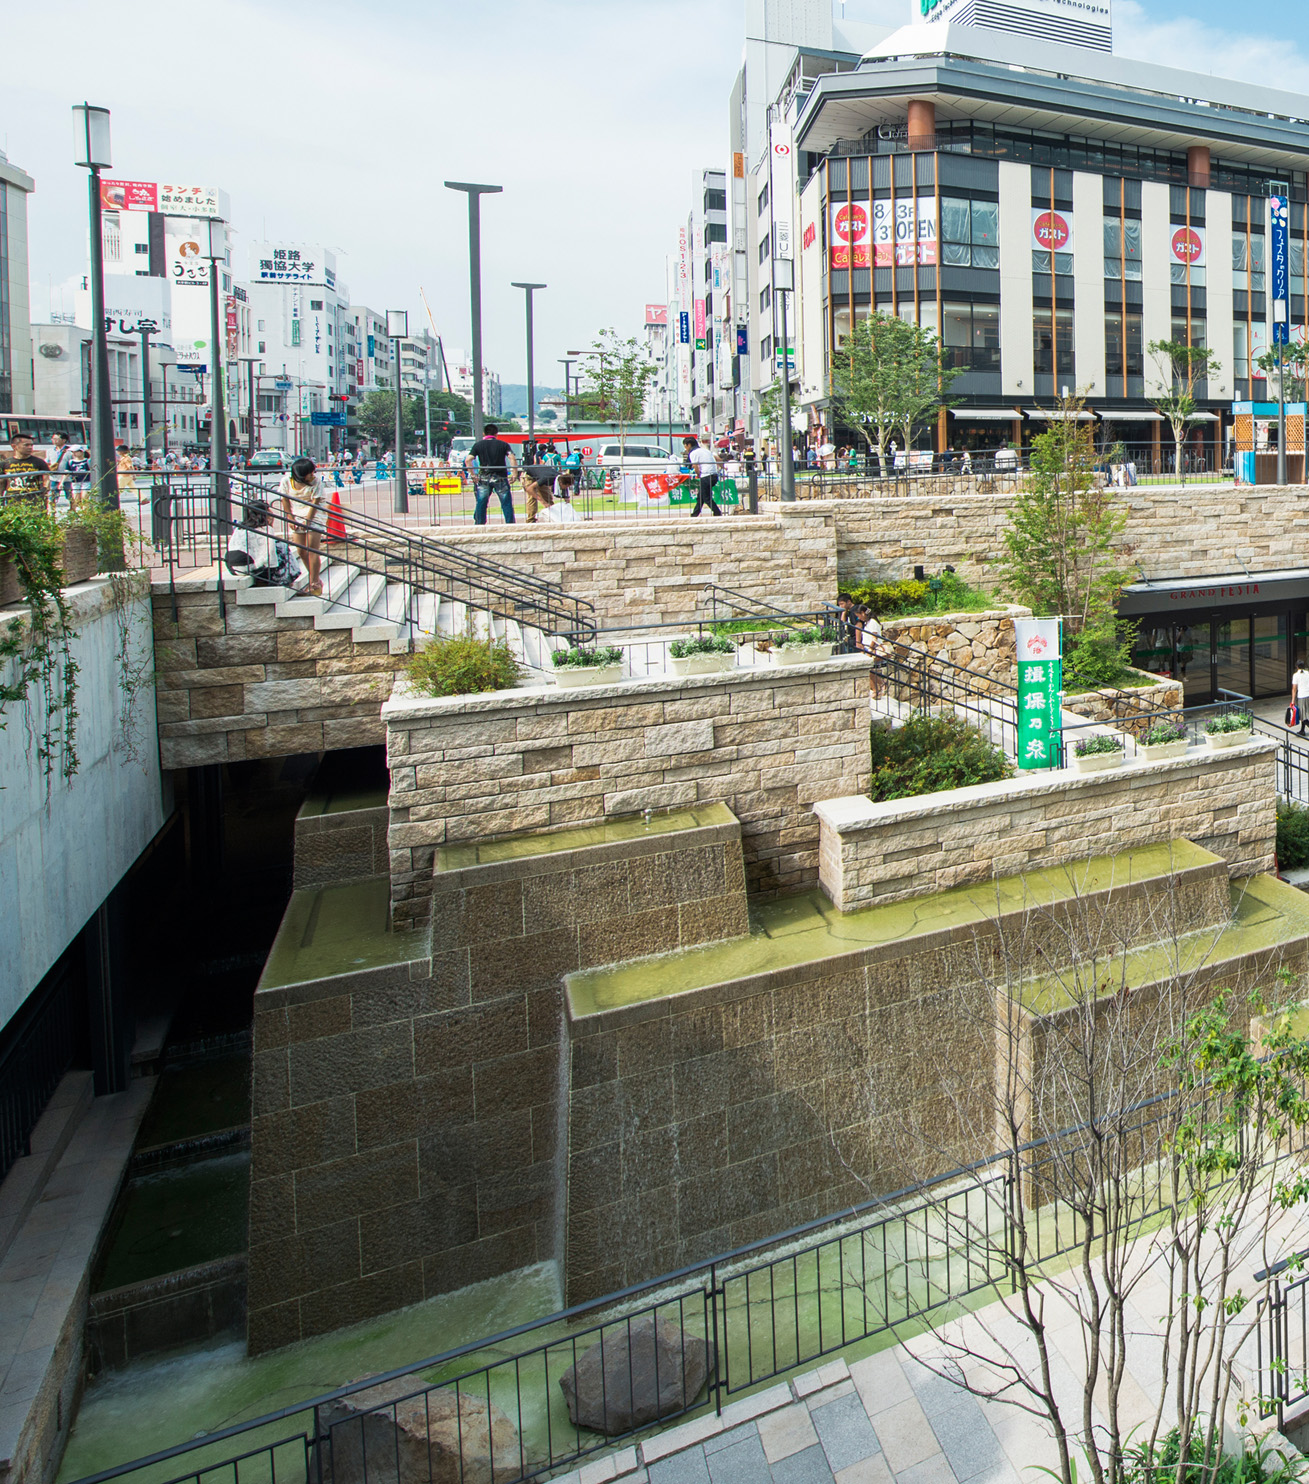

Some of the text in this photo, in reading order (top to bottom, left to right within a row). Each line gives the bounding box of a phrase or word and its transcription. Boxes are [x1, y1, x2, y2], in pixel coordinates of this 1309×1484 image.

[163, 185, 202, 196] ランチ
[161, 194, 217, 206] 始めました
[896, 219, 936, 240] OPEN
[273, 249, 301, 261] 姫路
[895, 244, 936, 264] ガスト
[259, 260, 315, 272] 獨協大学
[260, 271, 313, 280] 駅前サテライト
[1169, 584, 1260, 600] GRAND FESTA
